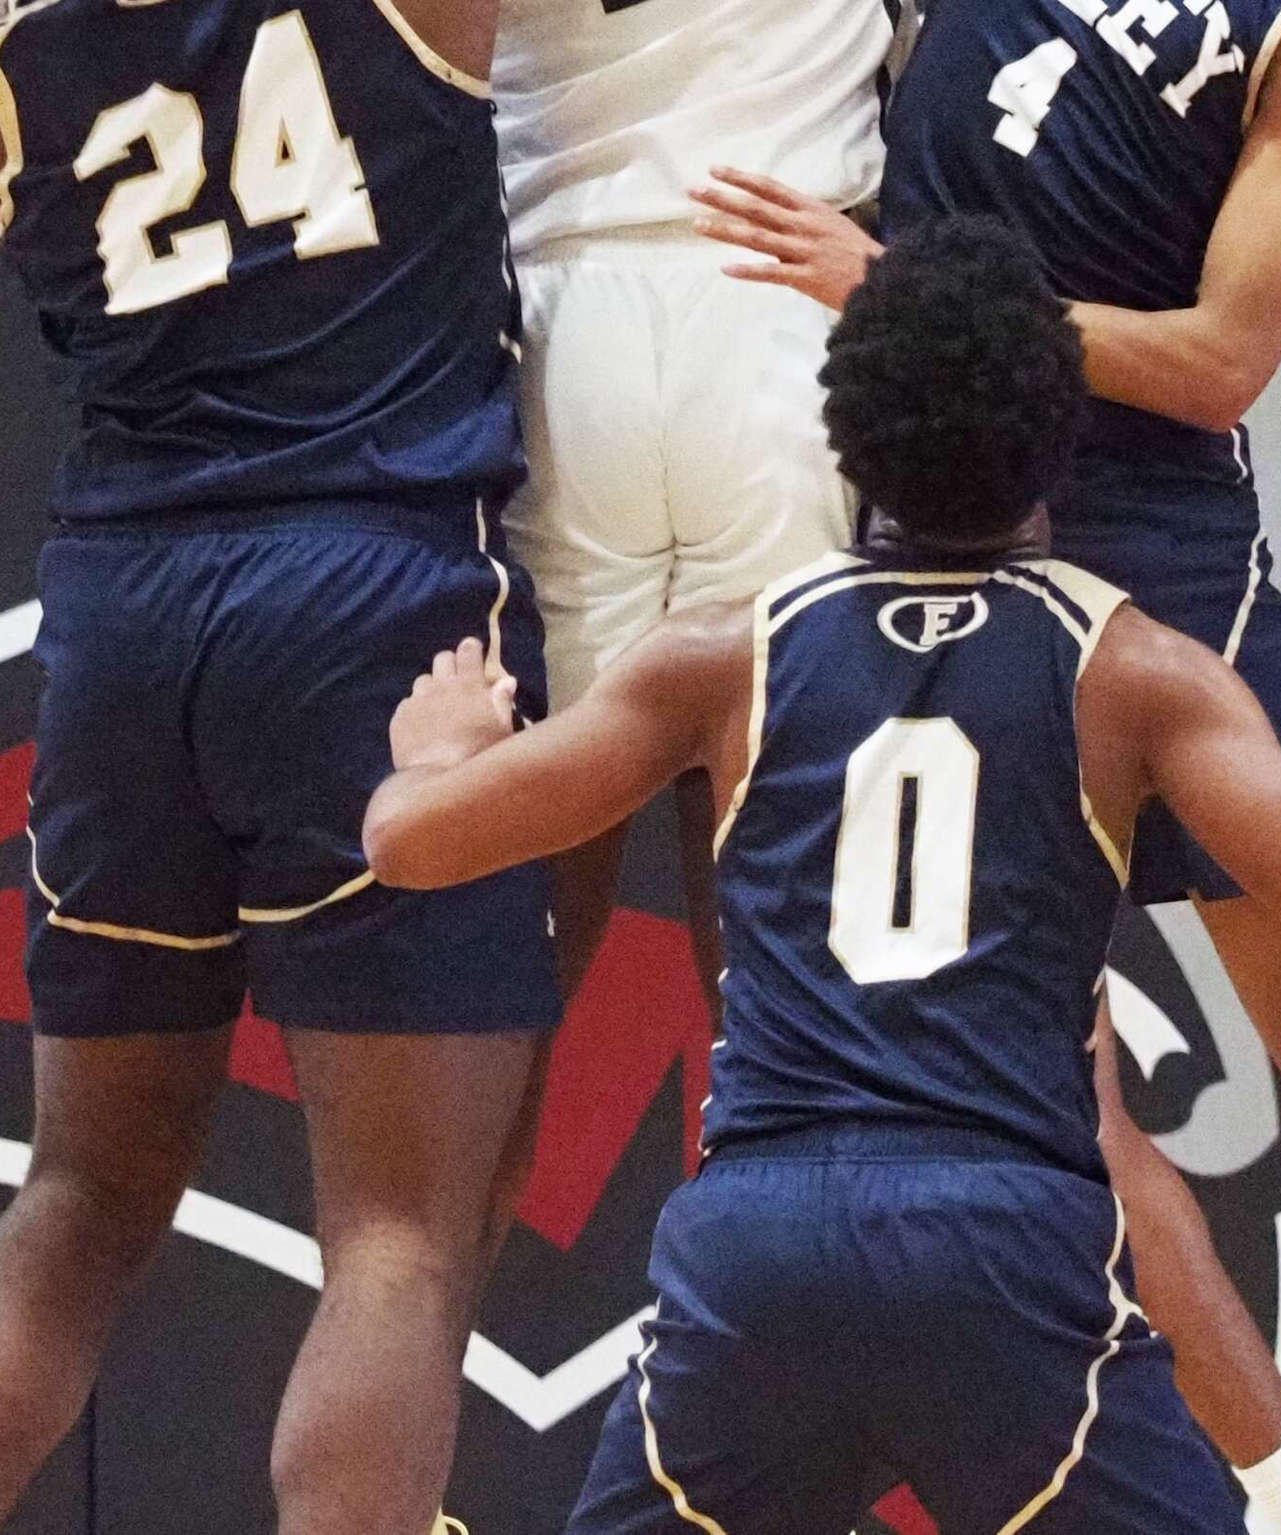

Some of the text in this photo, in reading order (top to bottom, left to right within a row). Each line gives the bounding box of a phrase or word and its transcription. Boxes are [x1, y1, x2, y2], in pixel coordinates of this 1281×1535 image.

[72, 9, 380, 315] 24
[987, 37, 1077, 158] 4
[827, 716, 980, 985] 0
